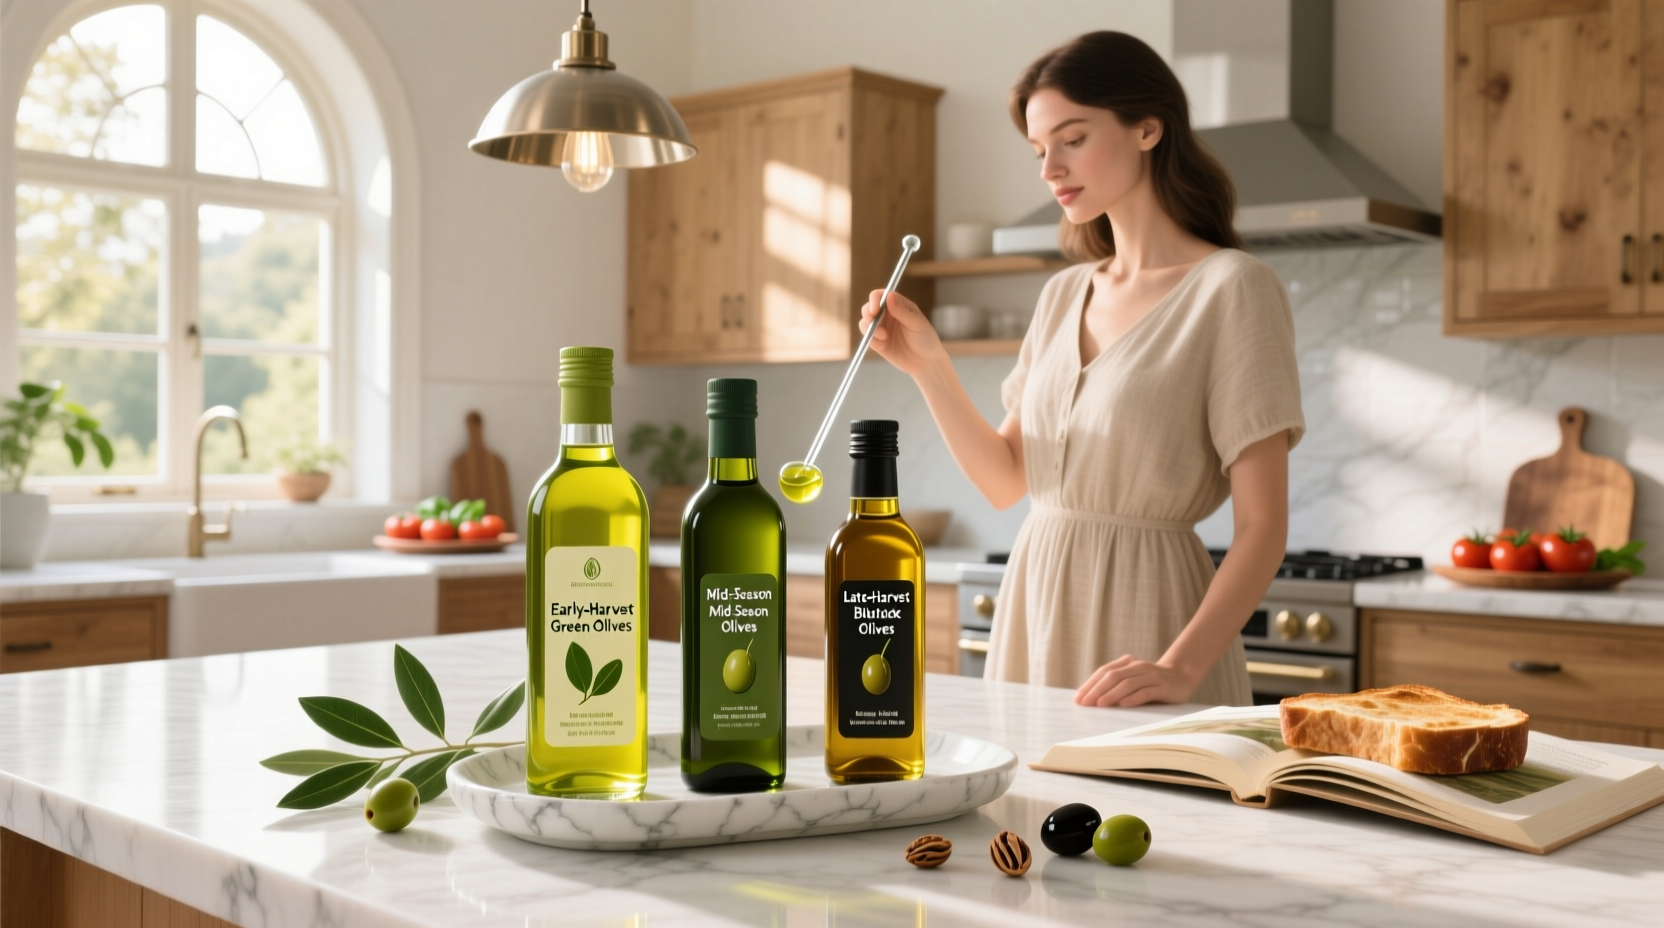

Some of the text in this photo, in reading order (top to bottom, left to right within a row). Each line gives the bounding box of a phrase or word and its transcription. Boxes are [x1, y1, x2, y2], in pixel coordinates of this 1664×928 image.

[709, 604, 732, 617] Mid
[550, 618, 590, 633] Green
[721, 619, 758, 633] Olives
[858, 622, 895, 635] Olives
